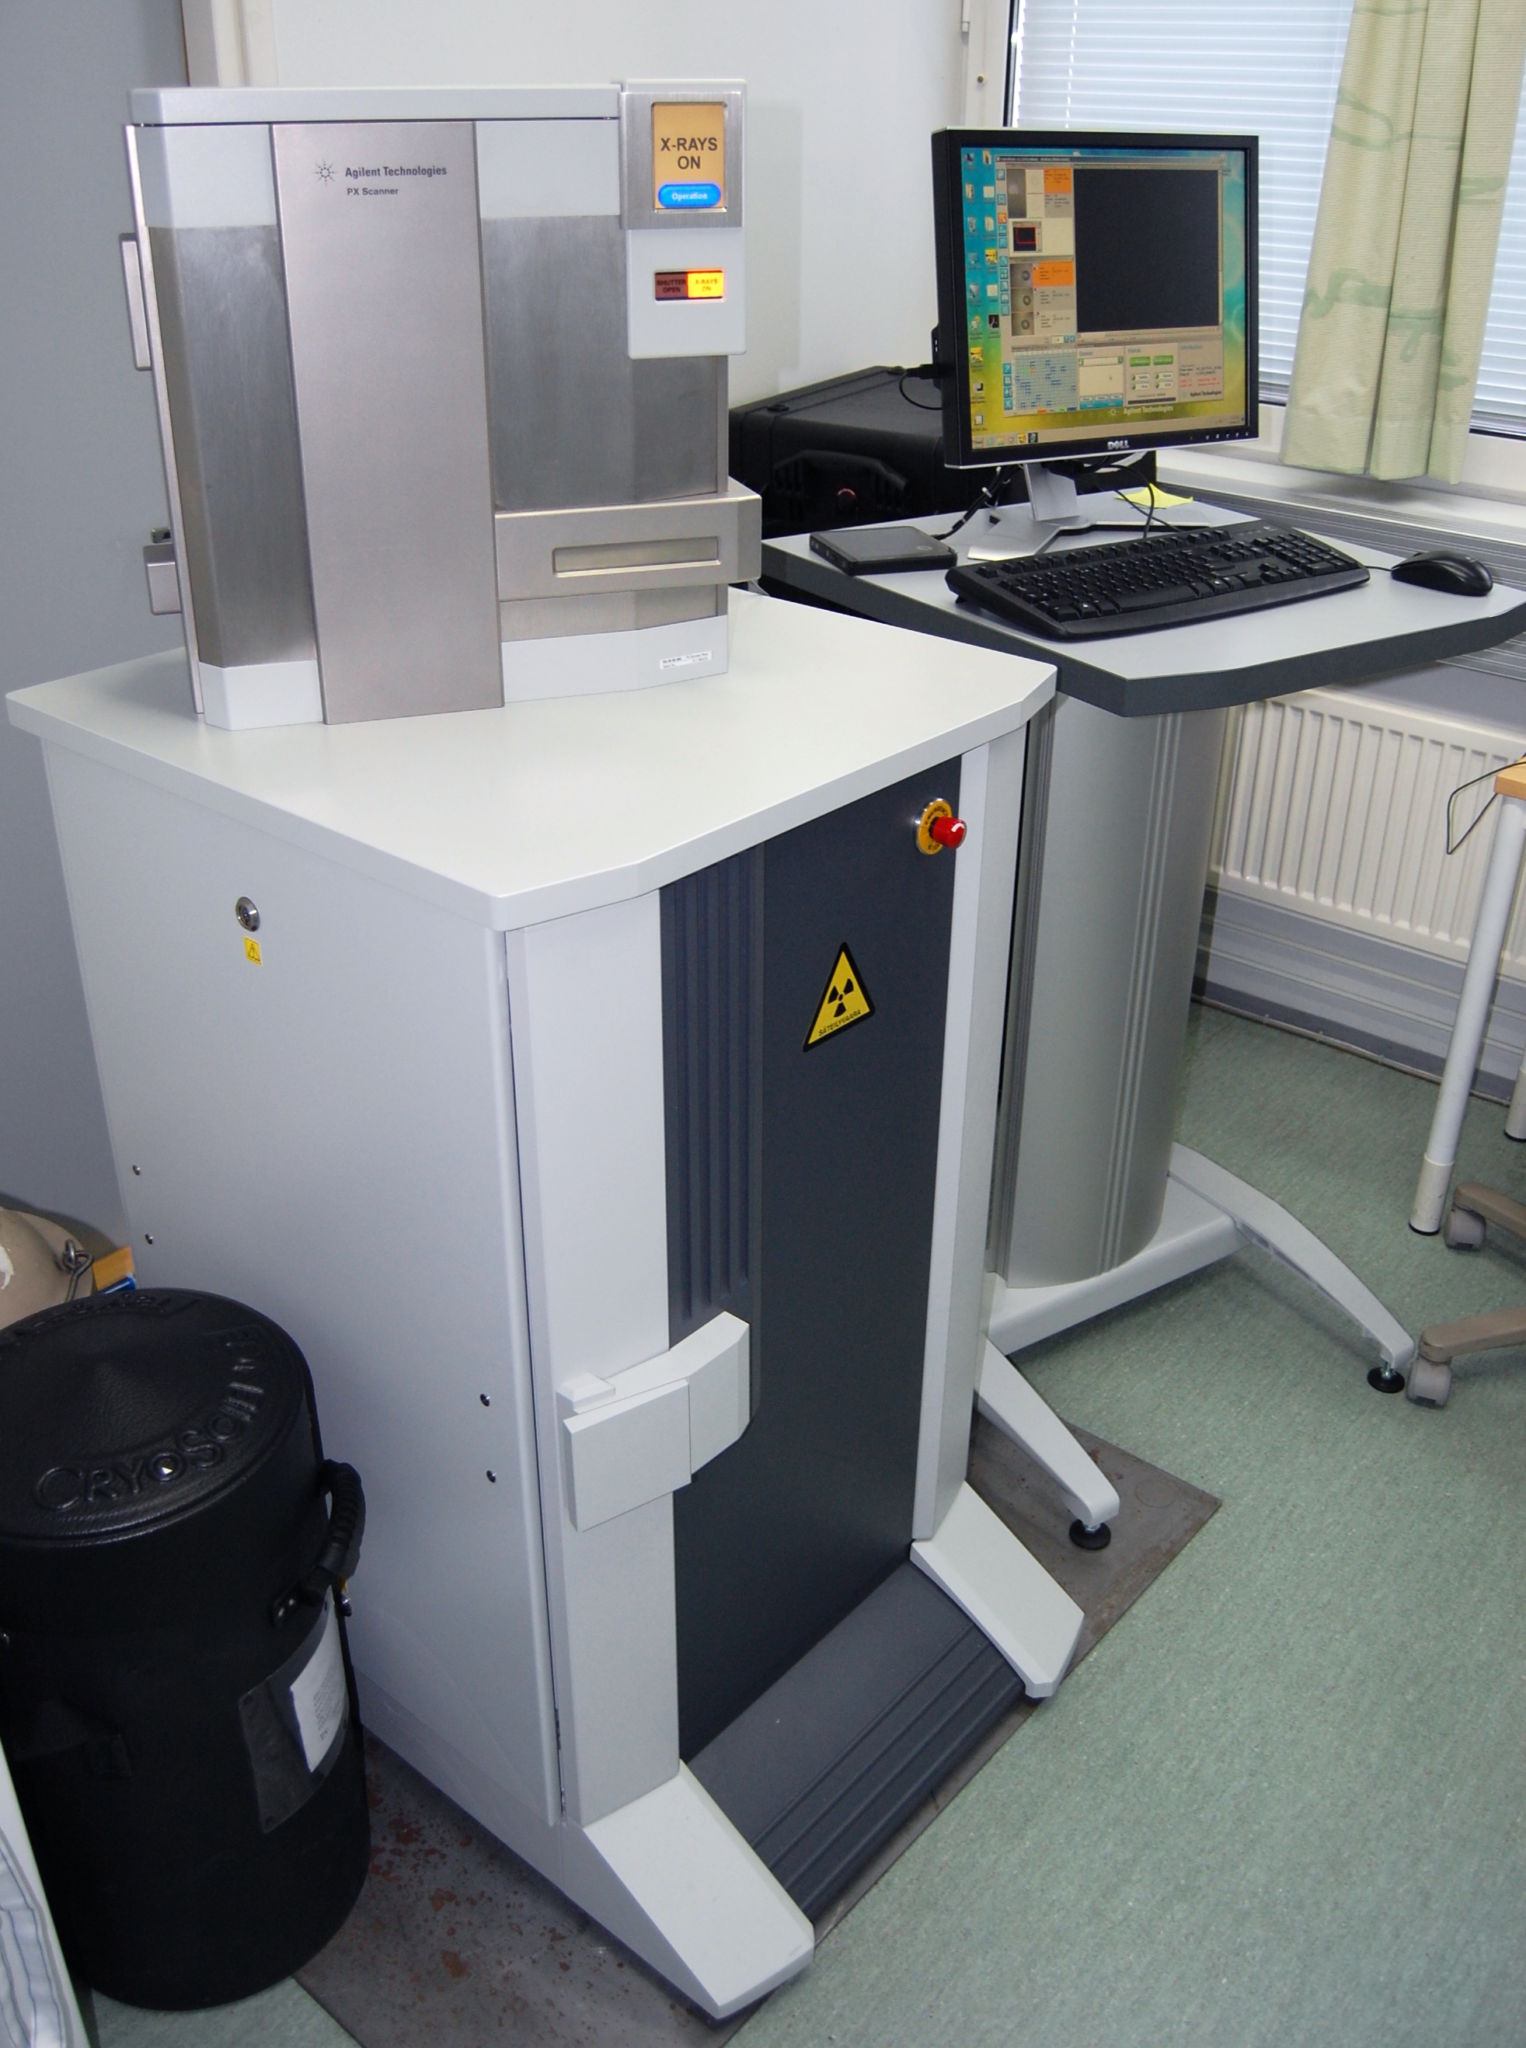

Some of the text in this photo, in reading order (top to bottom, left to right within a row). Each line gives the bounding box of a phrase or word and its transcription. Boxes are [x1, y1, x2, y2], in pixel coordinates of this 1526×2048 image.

[660, 137, 718, 151] X-RAYS
[677, 156, 701, 169] ON
[345, 165, 447, 179] Agilent Technologies
[347, 187, 399, 196] PX Scanner
[1107, 440, 1129, 450] DELL
